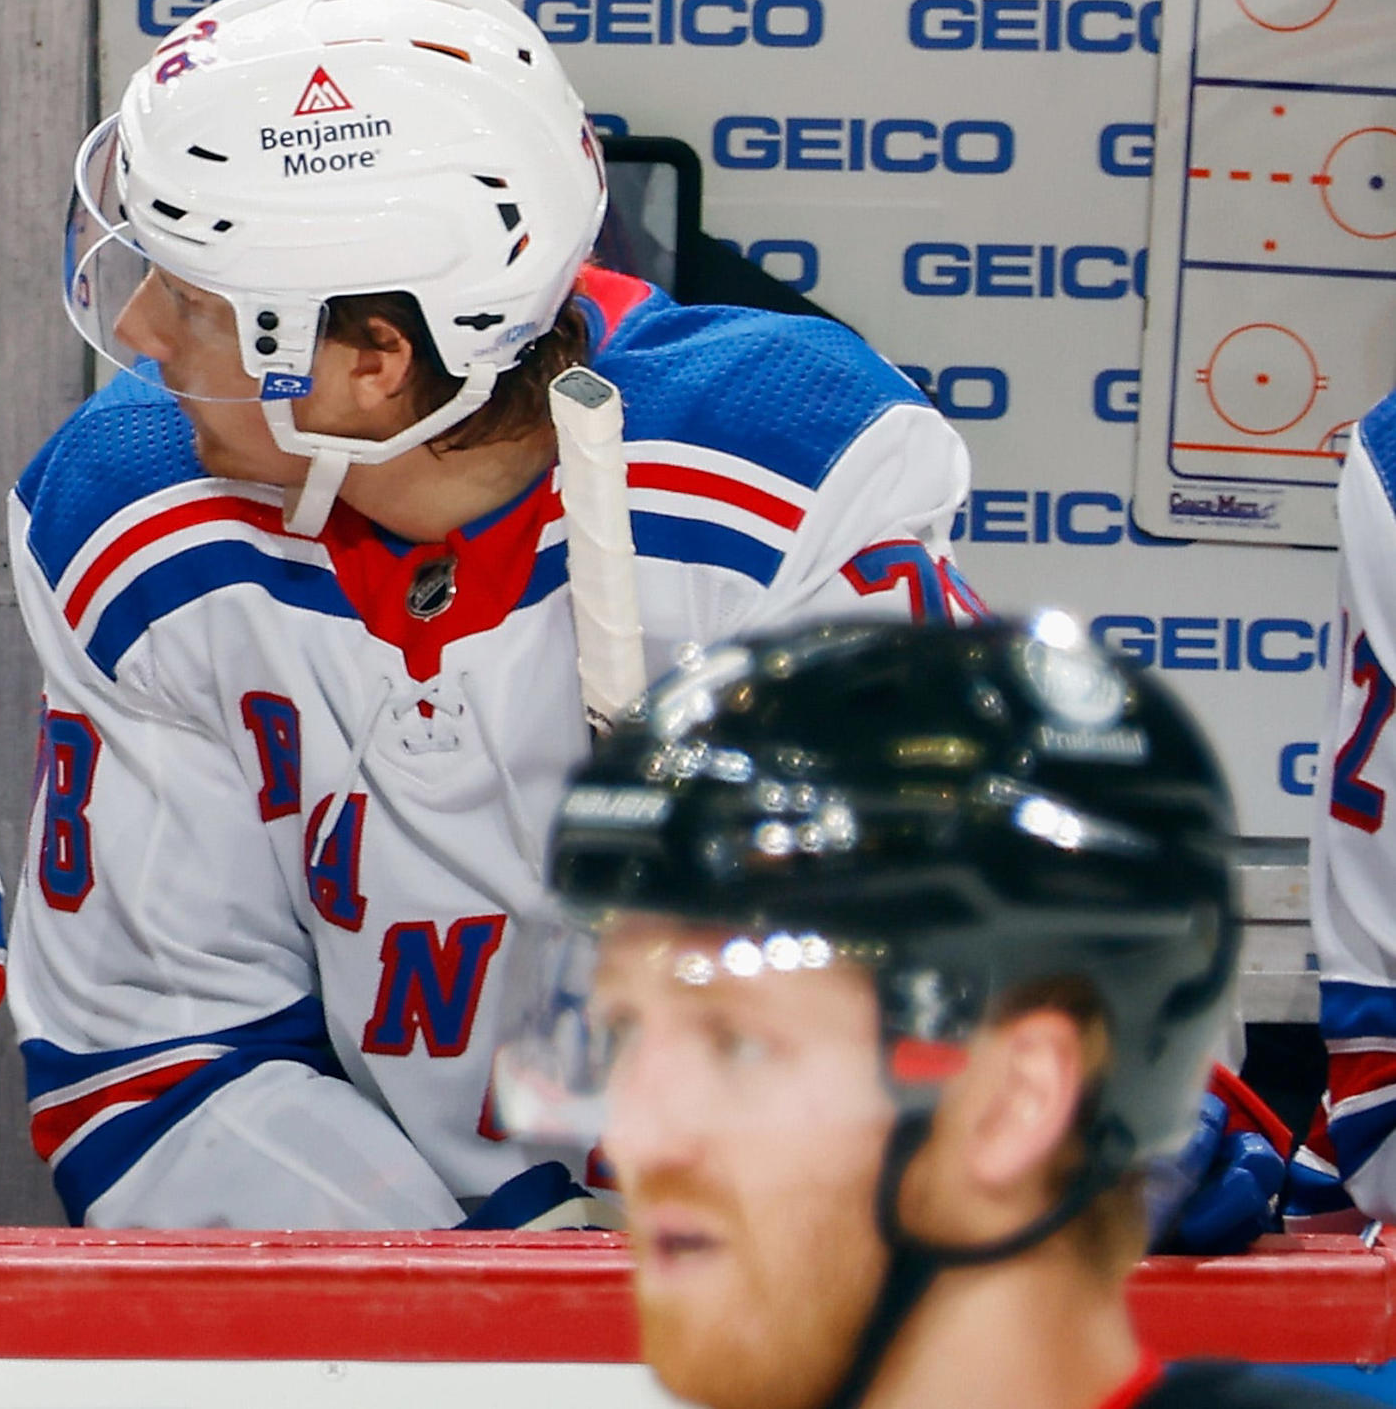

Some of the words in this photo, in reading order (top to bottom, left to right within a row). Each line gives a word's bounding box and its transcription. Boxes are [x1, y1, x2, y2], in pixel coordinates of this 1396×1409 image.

[261, 114, 392, 150] Benjamin
[713, 117, 1016, 175] GEICO
[284, 147, 376, 177] Moore
[903, 242, 1148, 300] GEIC
[949, 491, 1194, 547] EIC
[1090, 615, 1330, 672] GEIC
